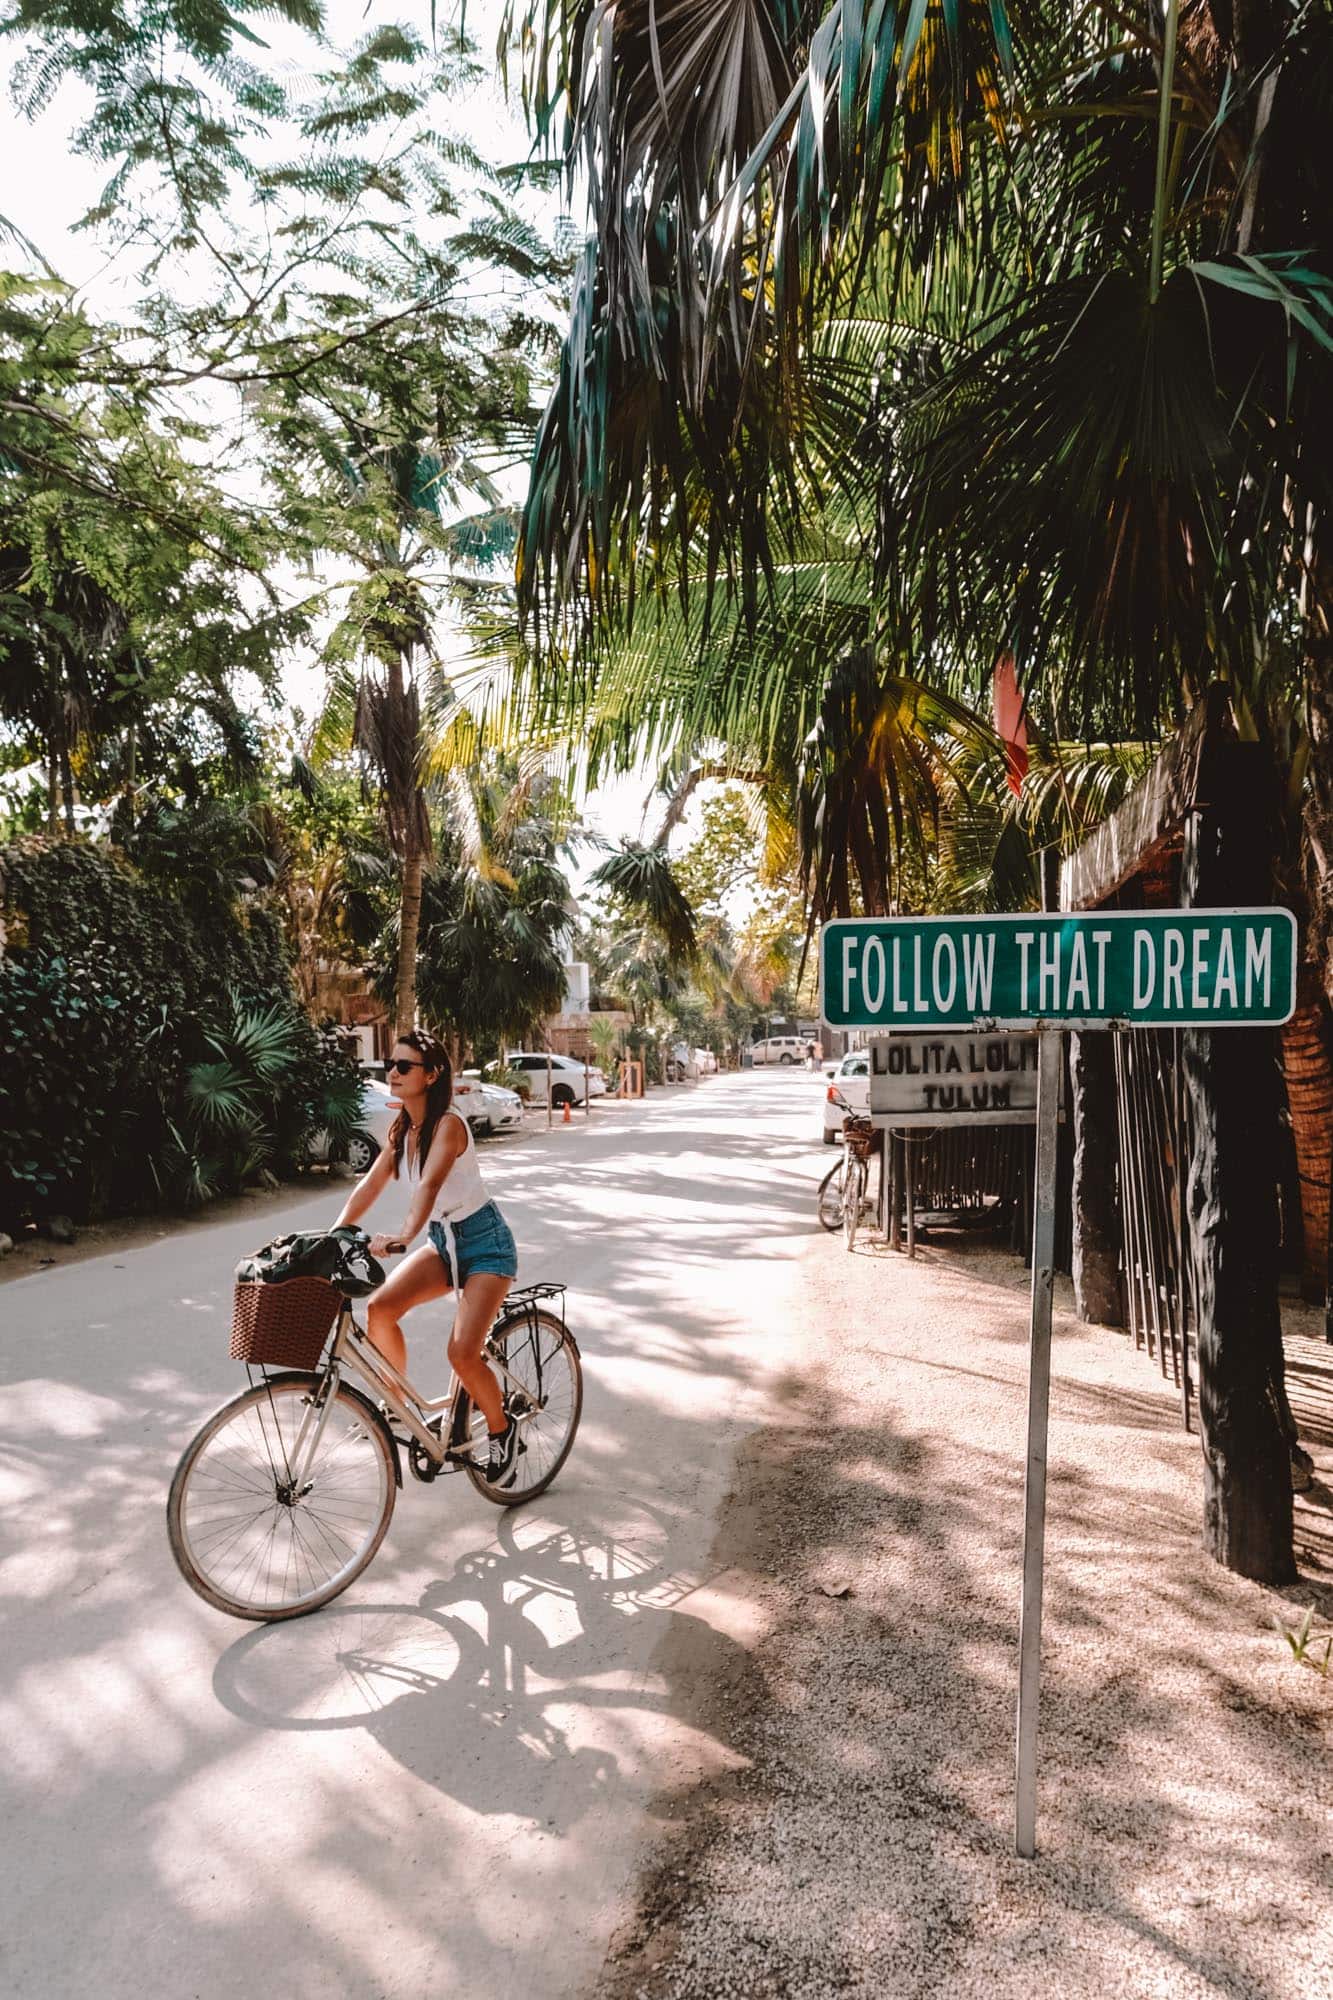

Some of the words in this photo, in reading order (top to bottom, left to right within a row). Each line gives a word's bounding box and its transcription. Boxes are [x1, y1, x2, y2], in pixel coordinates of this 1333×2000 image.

[842, 932, 996, 1014] FOLLOW
[1014, 930, 1112, 1011] THAT
[1133, 927, 1273, 1010] DREAM
[872, 1042, 962, 1075] LOLITA
[968, 1039, 1039, 1073] LOLIT
[923, 1083, 1012, 1111] TULUM
